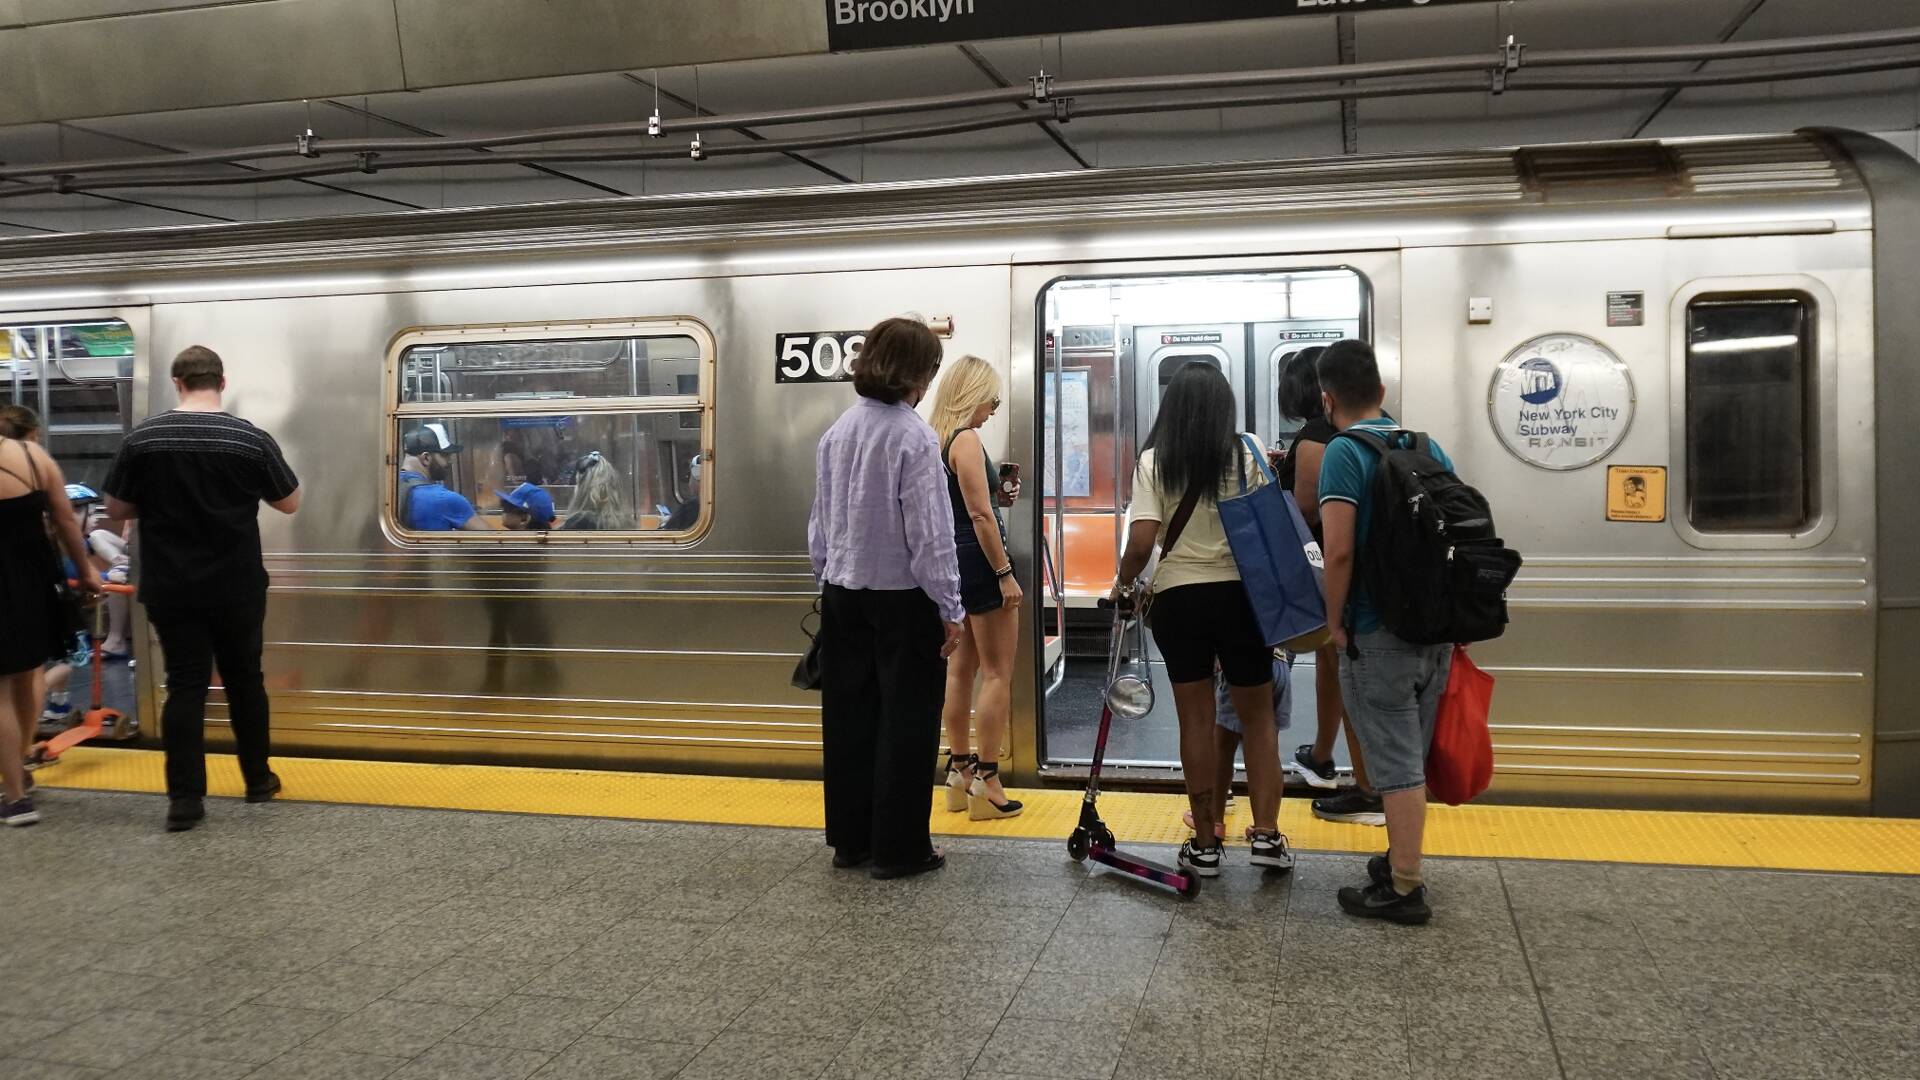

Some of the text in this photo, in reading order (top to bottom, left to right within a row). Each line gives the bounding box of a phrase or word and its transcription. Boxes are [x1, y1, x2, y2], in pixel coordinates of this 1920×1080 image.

[834, 0, 974, 25] Brooklyn
[1520, 406, 1619, 422] New York City
[1519, 424, 1578, 437] Subway
